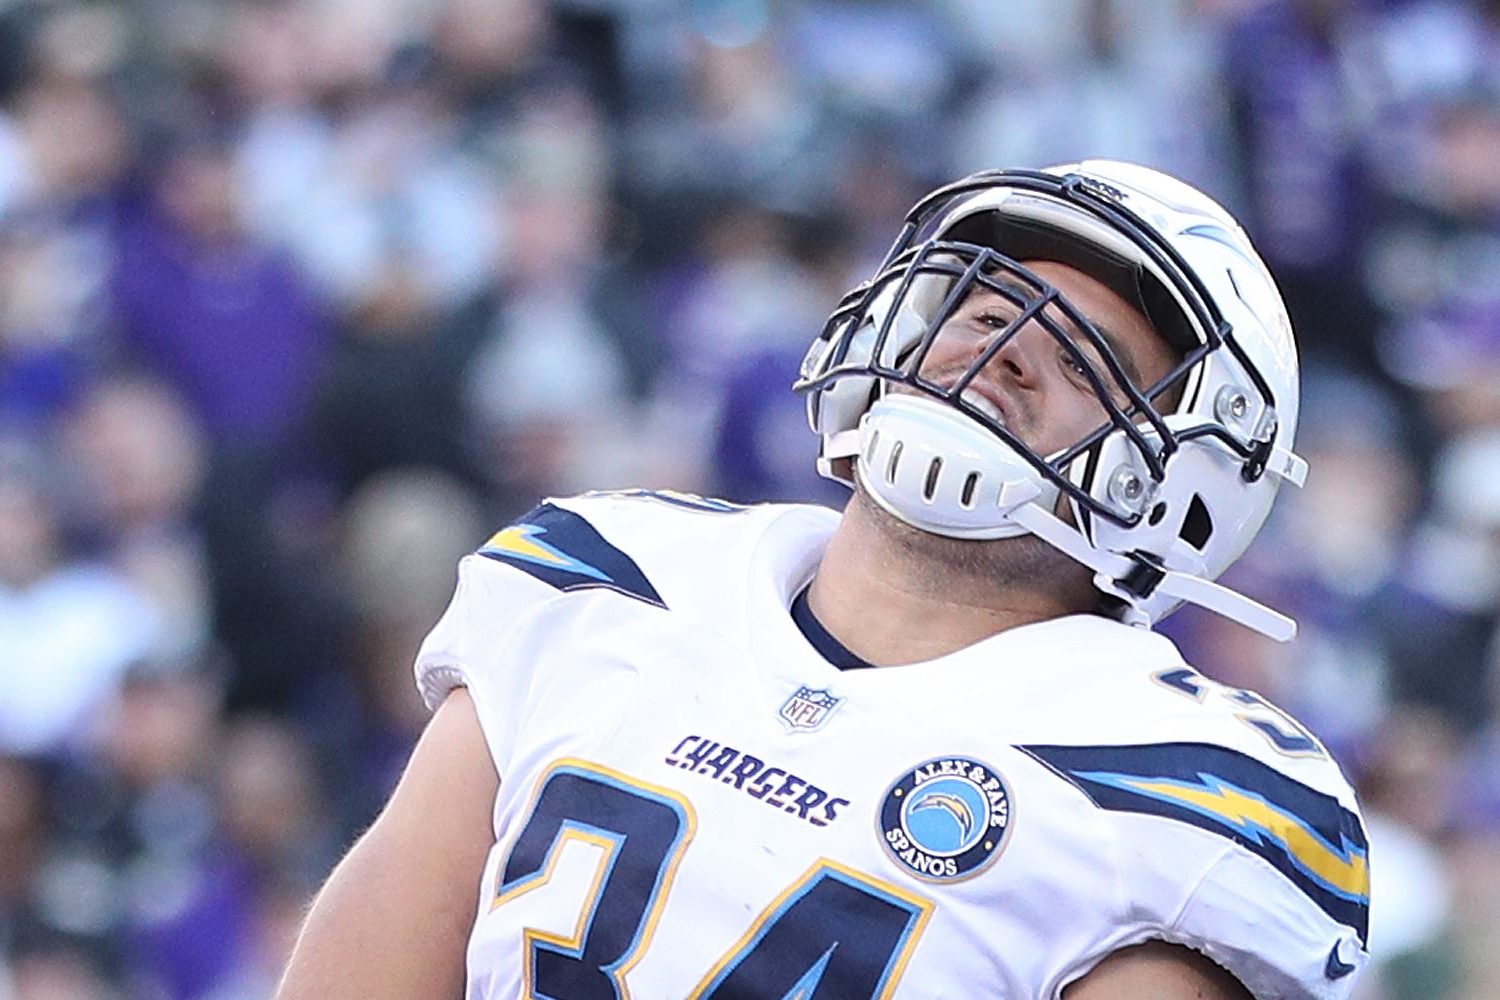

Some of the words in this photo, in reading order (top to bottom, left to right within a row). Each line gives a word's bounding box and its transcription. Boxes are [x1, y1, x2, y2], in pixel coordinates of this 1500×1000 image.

[785, 699, 822, 725] NFL
[665, 735, 850, 826] CHARGERS
[914, 760, 970, 785] ALEX
[968, 766, 985, 784] &
[982, 777, 1008, 828] FAYE
[886, 828, 958, 876] SPANOS
